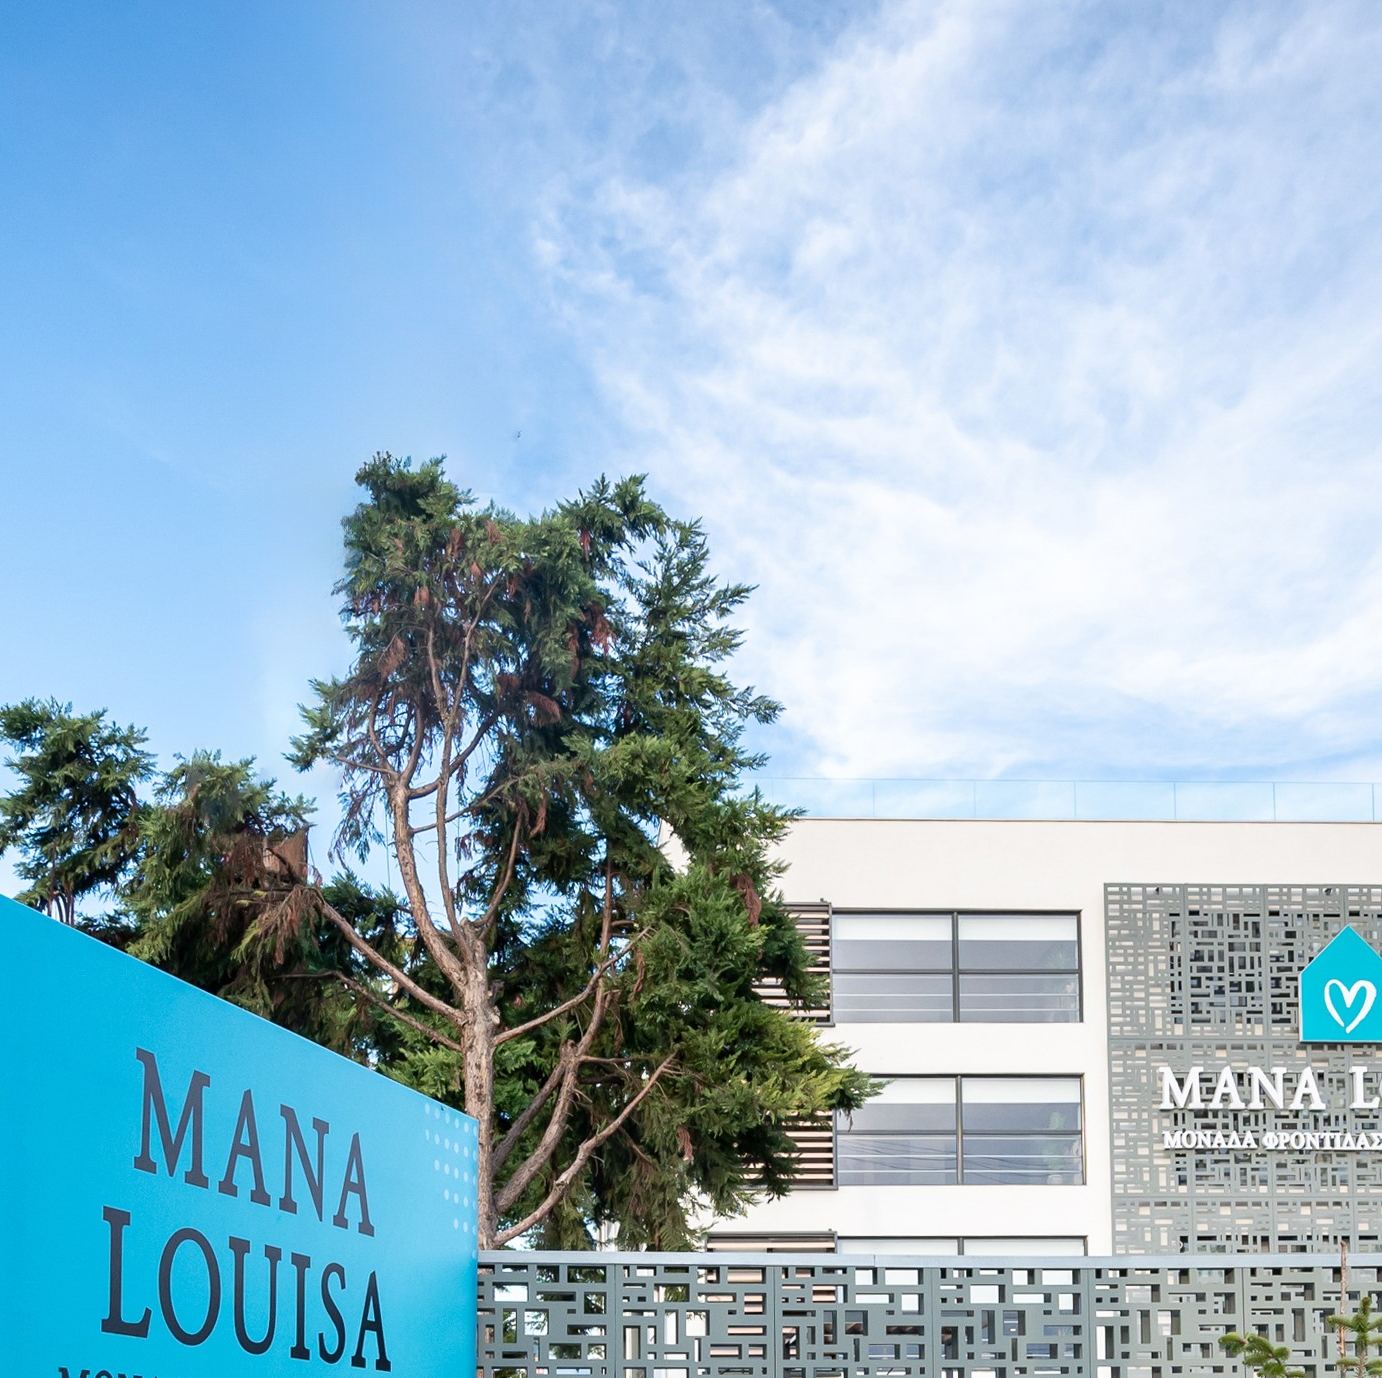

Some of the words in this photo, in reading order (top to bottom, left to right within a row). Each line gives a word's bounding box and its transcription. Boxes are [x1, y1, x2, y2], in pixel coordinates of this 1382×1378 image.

[1158, 1065, 1326, 1111] MANA
[1162, 1130, 1258, 1150] ΜΟΝΑΔΑ
[133, 1046, 375, 1237] MANA
[101, 1205, 392, 1372] LOUISA
